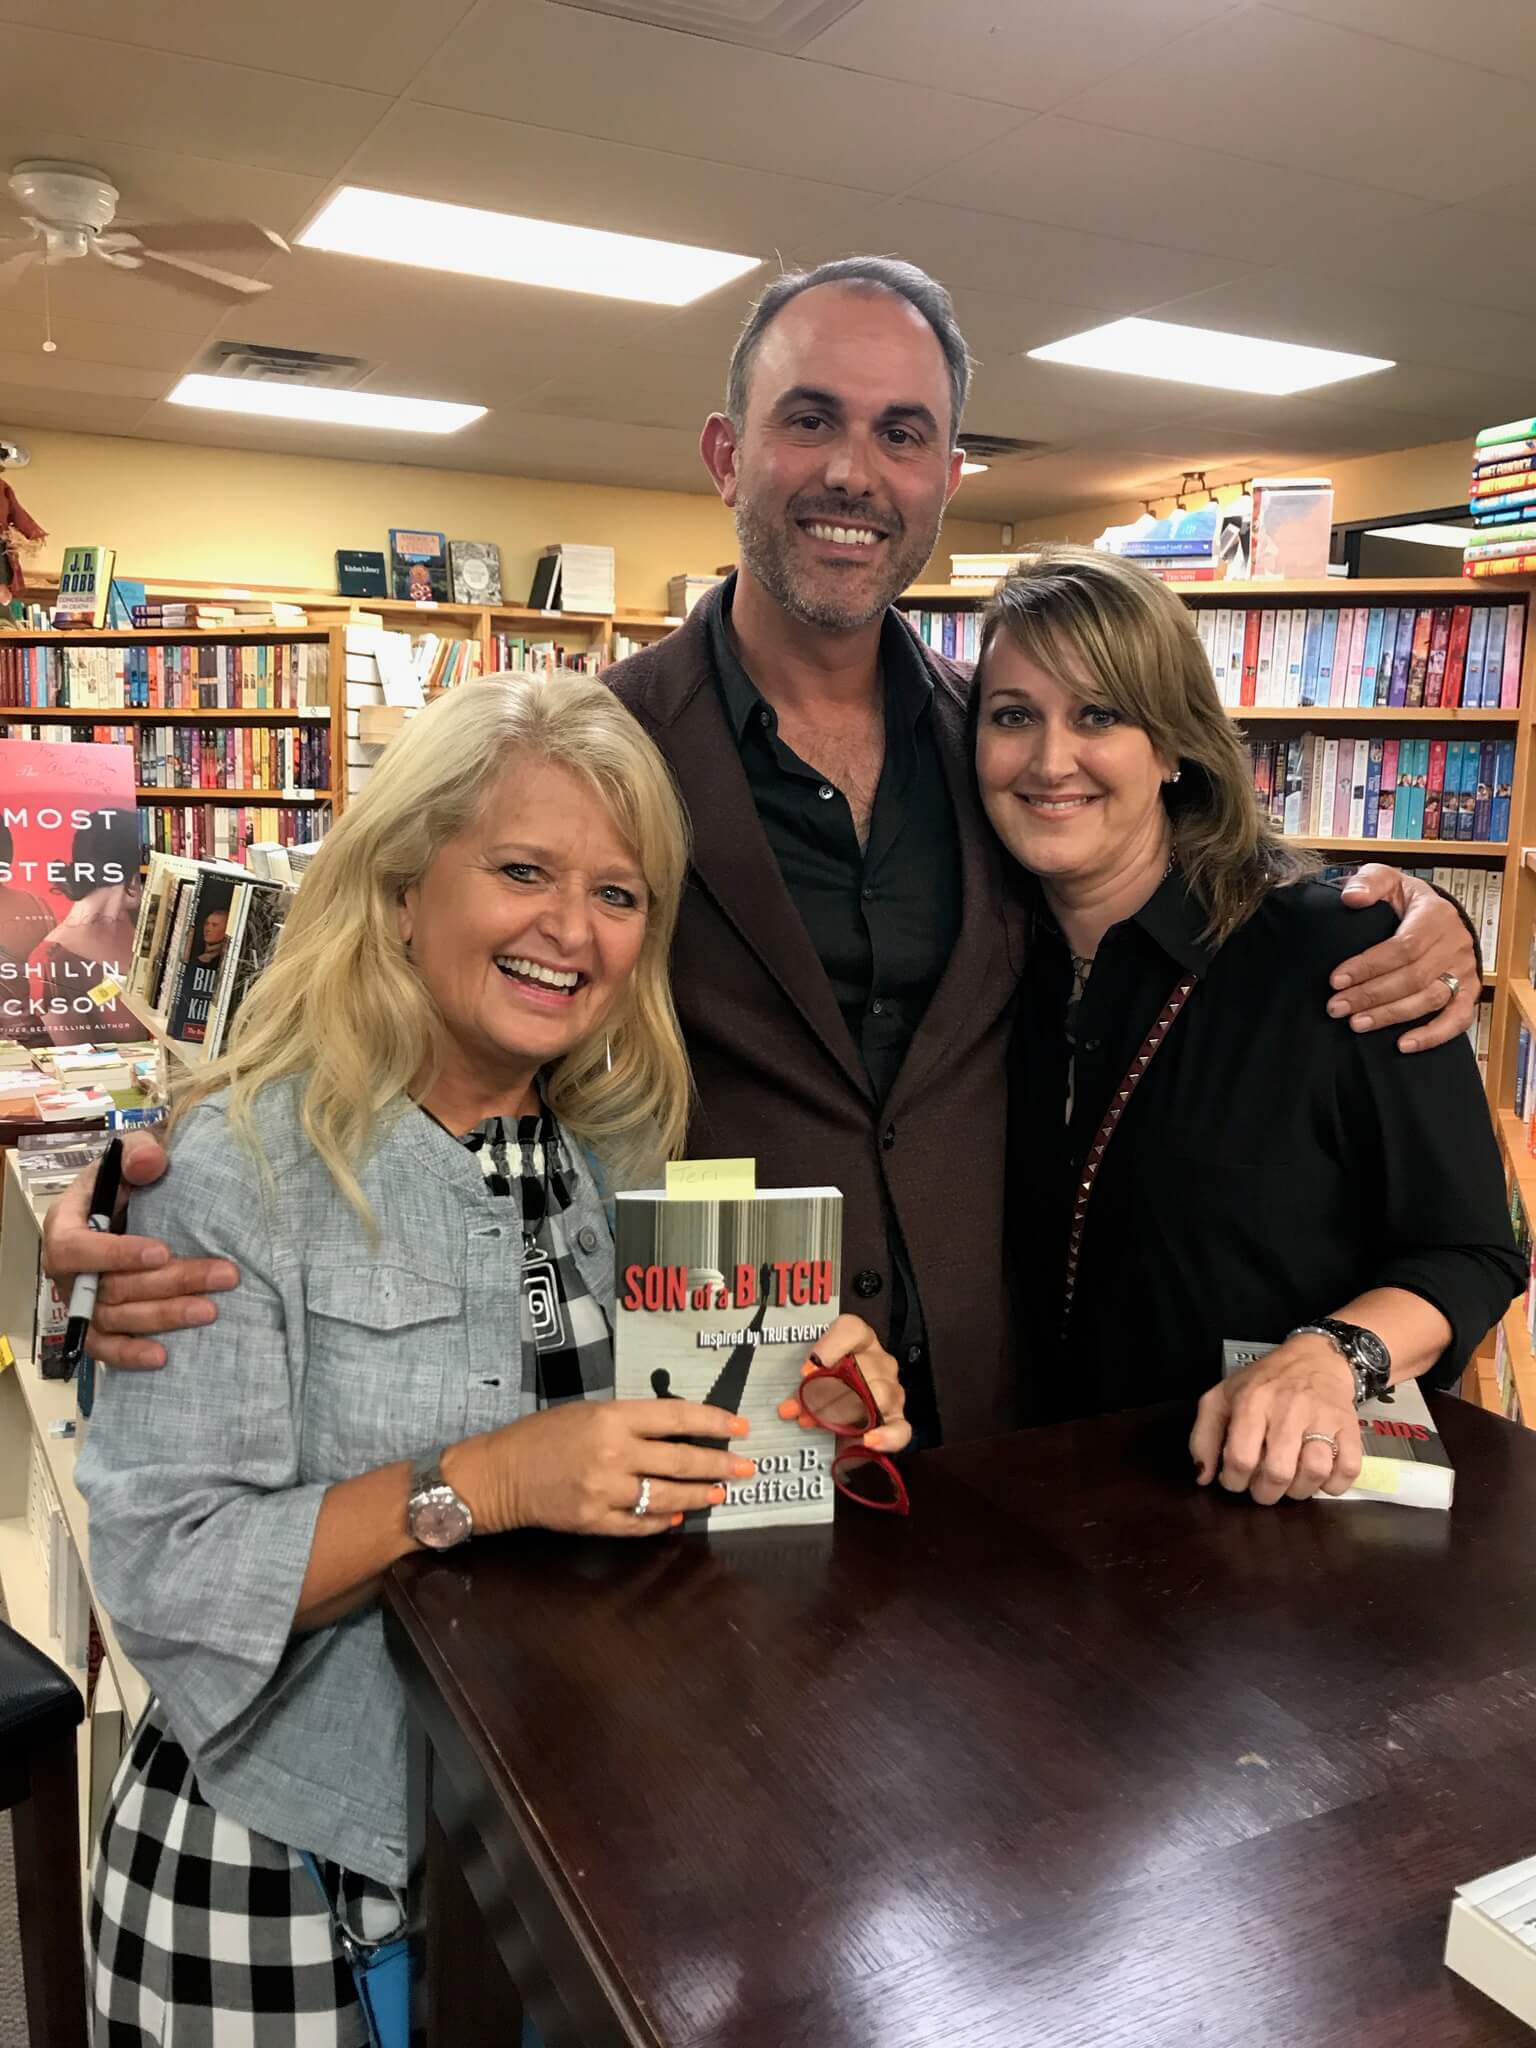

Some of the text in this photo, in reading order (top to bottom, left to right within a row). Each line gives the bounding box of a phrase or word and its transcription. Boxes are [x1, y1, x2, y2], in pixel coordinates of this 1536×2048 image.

[70, 552, 93, 572] J. D.
[62, 574, 95, 592] ROBB
[3, 807, 118, 830] MOST
[0, 960, 119, 980] SHILYN
[192, 967, 216, 993] BIL
[30, 1023, 91, 1033] BESTSELLING
[94, 1022, 130, 1030] AUTHOR
[624, 1263, 688, 1312] SON
[692, 1281, 714, 1310] of
[717, 1287, 729, 1310] a
[699, 1328, 744, 1350] Inspired
[747, 1328, 760, 1347] by
[762, 1327, 789, 1343] TRUE
[1372, 1420, 1430, 1440] SON
[800, 1447, 825, 1471] B.
[714, 1475, 824, 1506] heffield
